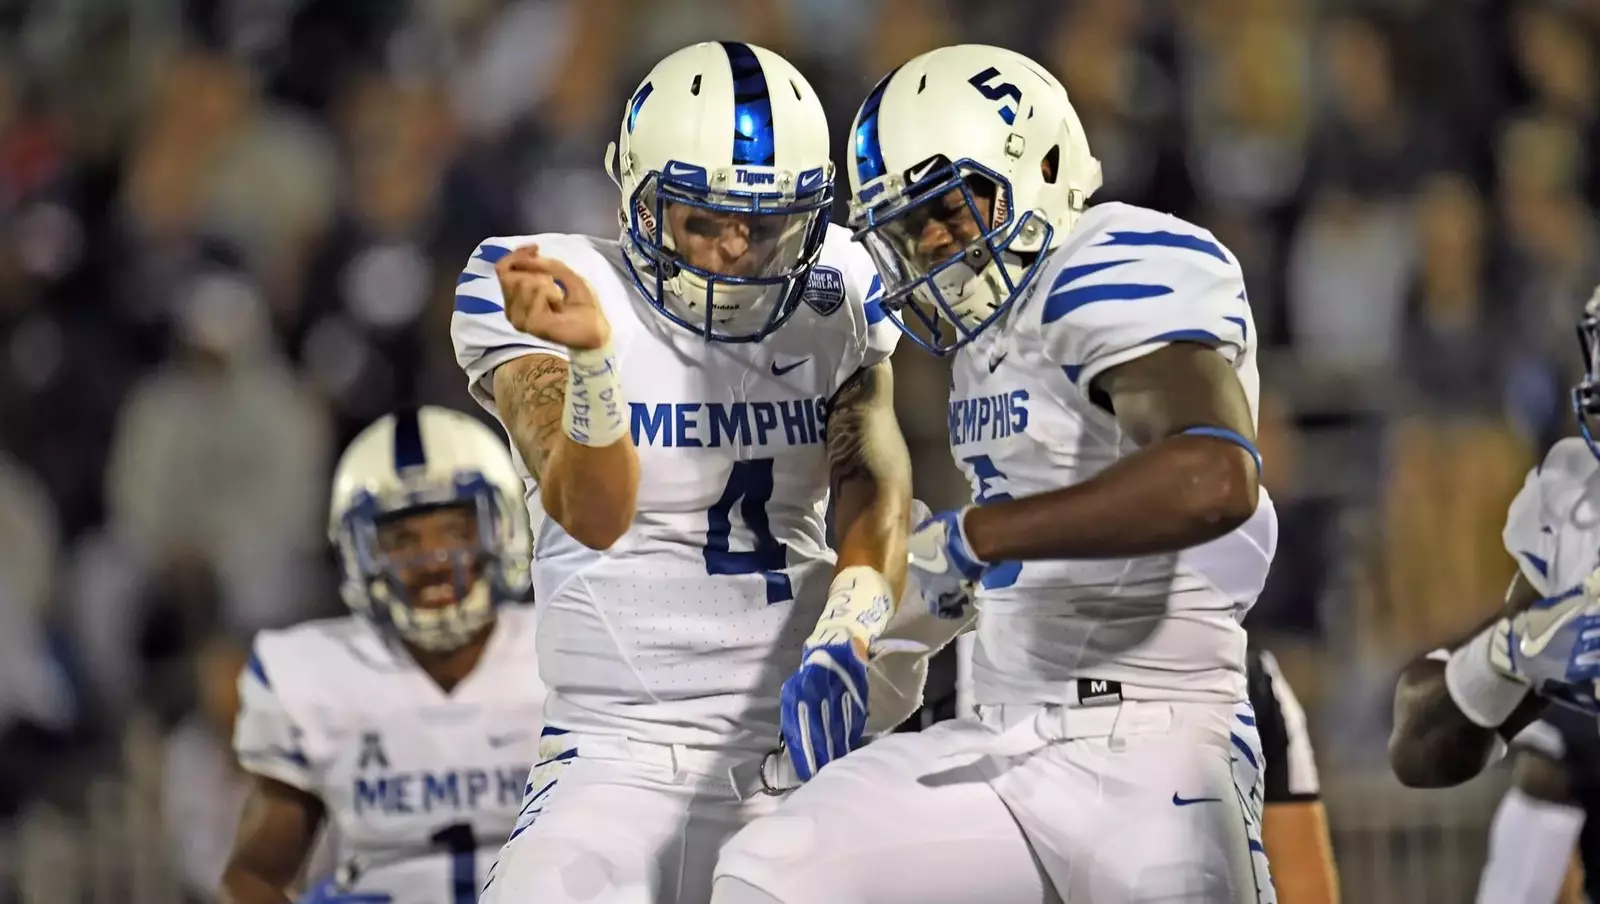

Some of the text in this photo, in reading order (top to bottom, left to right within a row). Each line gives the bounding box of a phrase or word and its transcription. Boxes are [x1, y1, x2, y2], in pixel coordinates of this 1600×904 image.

[967, 66, 1023, 126] 5
[735, 169, 775, 186] Tigers
[702, 457, 793, 604] 4
[1091, 680, 1107, 693] M
[429, 821, 477, 904] 1
